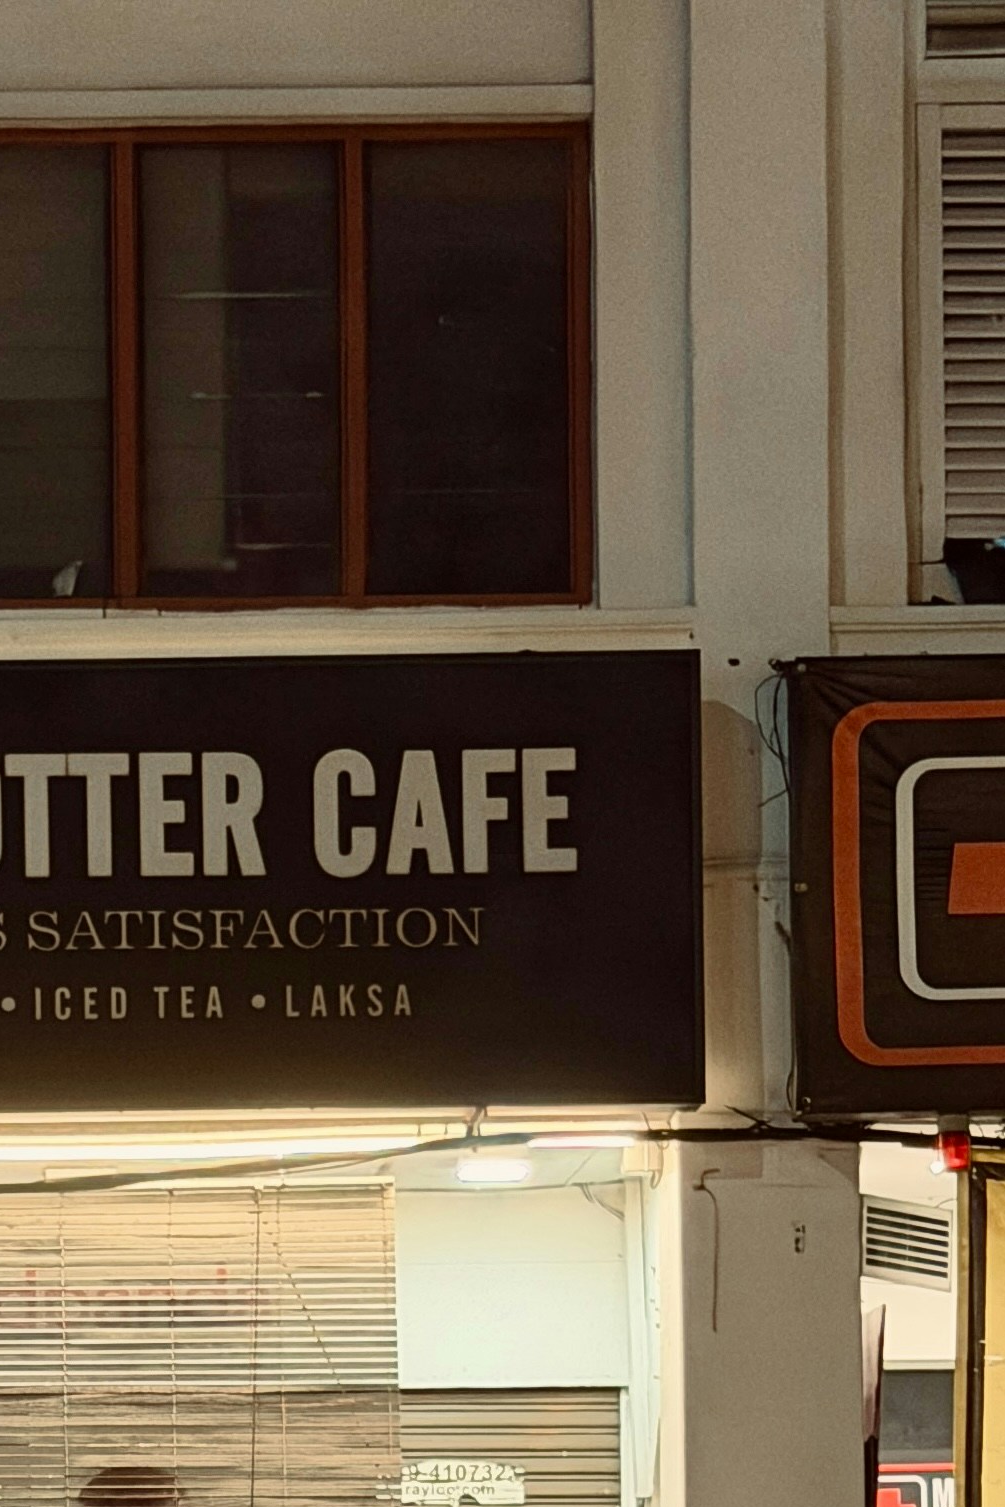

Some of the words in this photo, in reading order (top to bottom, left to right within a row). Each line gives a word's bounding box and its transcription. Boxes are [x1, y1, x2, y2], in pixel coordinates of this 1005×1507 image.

[313, 747, 578, 878] CAFE
[26, 907, 484, 951] SATISFACTION
[34, 986, 129, 1021] ICED
[153, 986, 224, 1019] TEA
[286, 984, 412, 1017] LAKSA
